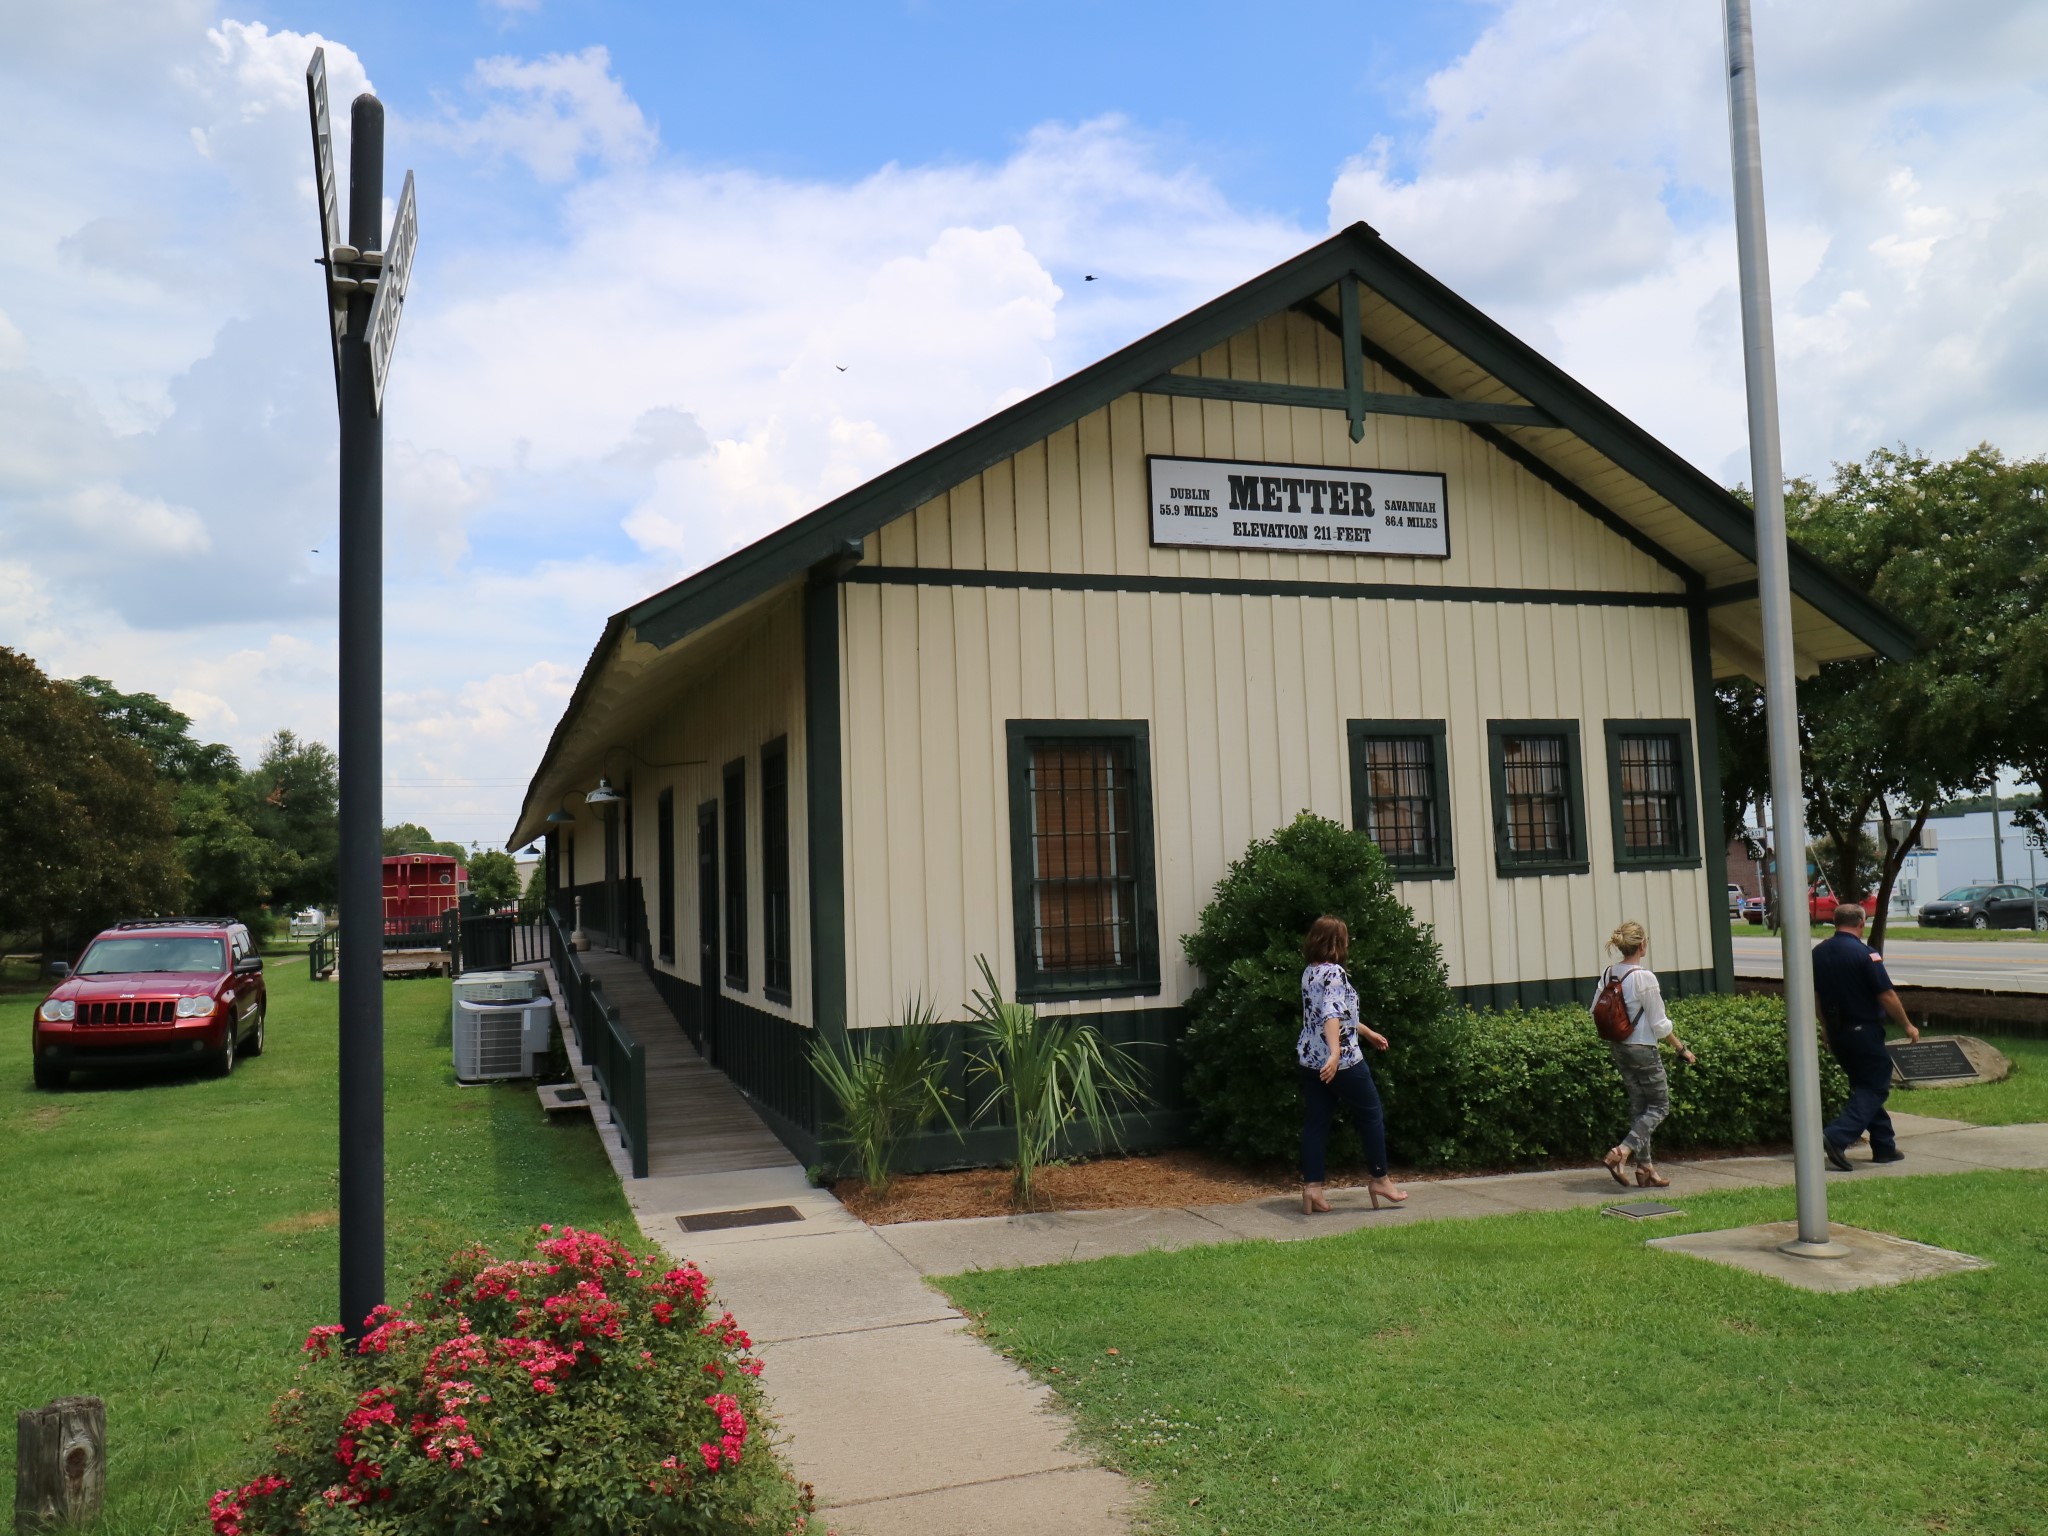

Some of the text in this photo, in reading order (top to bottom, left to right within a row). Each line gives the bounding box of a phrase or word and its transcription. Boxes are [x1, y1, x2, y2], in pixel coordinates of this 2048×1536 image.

[374, 197, 414, 387] CROSSING
[1170, 488, 1210, 500] DUBLIN
[1228, 475, 1375, 517] METTER
[1160, 504, 1218, 518] 55.9 MILES
[1385, 500, 1436, 513] SAVANNAH
[1385, 516, 1437, 528] 86.4 MILES
[1233, 522, 1371, 542] ELEVATION 211 FEET
